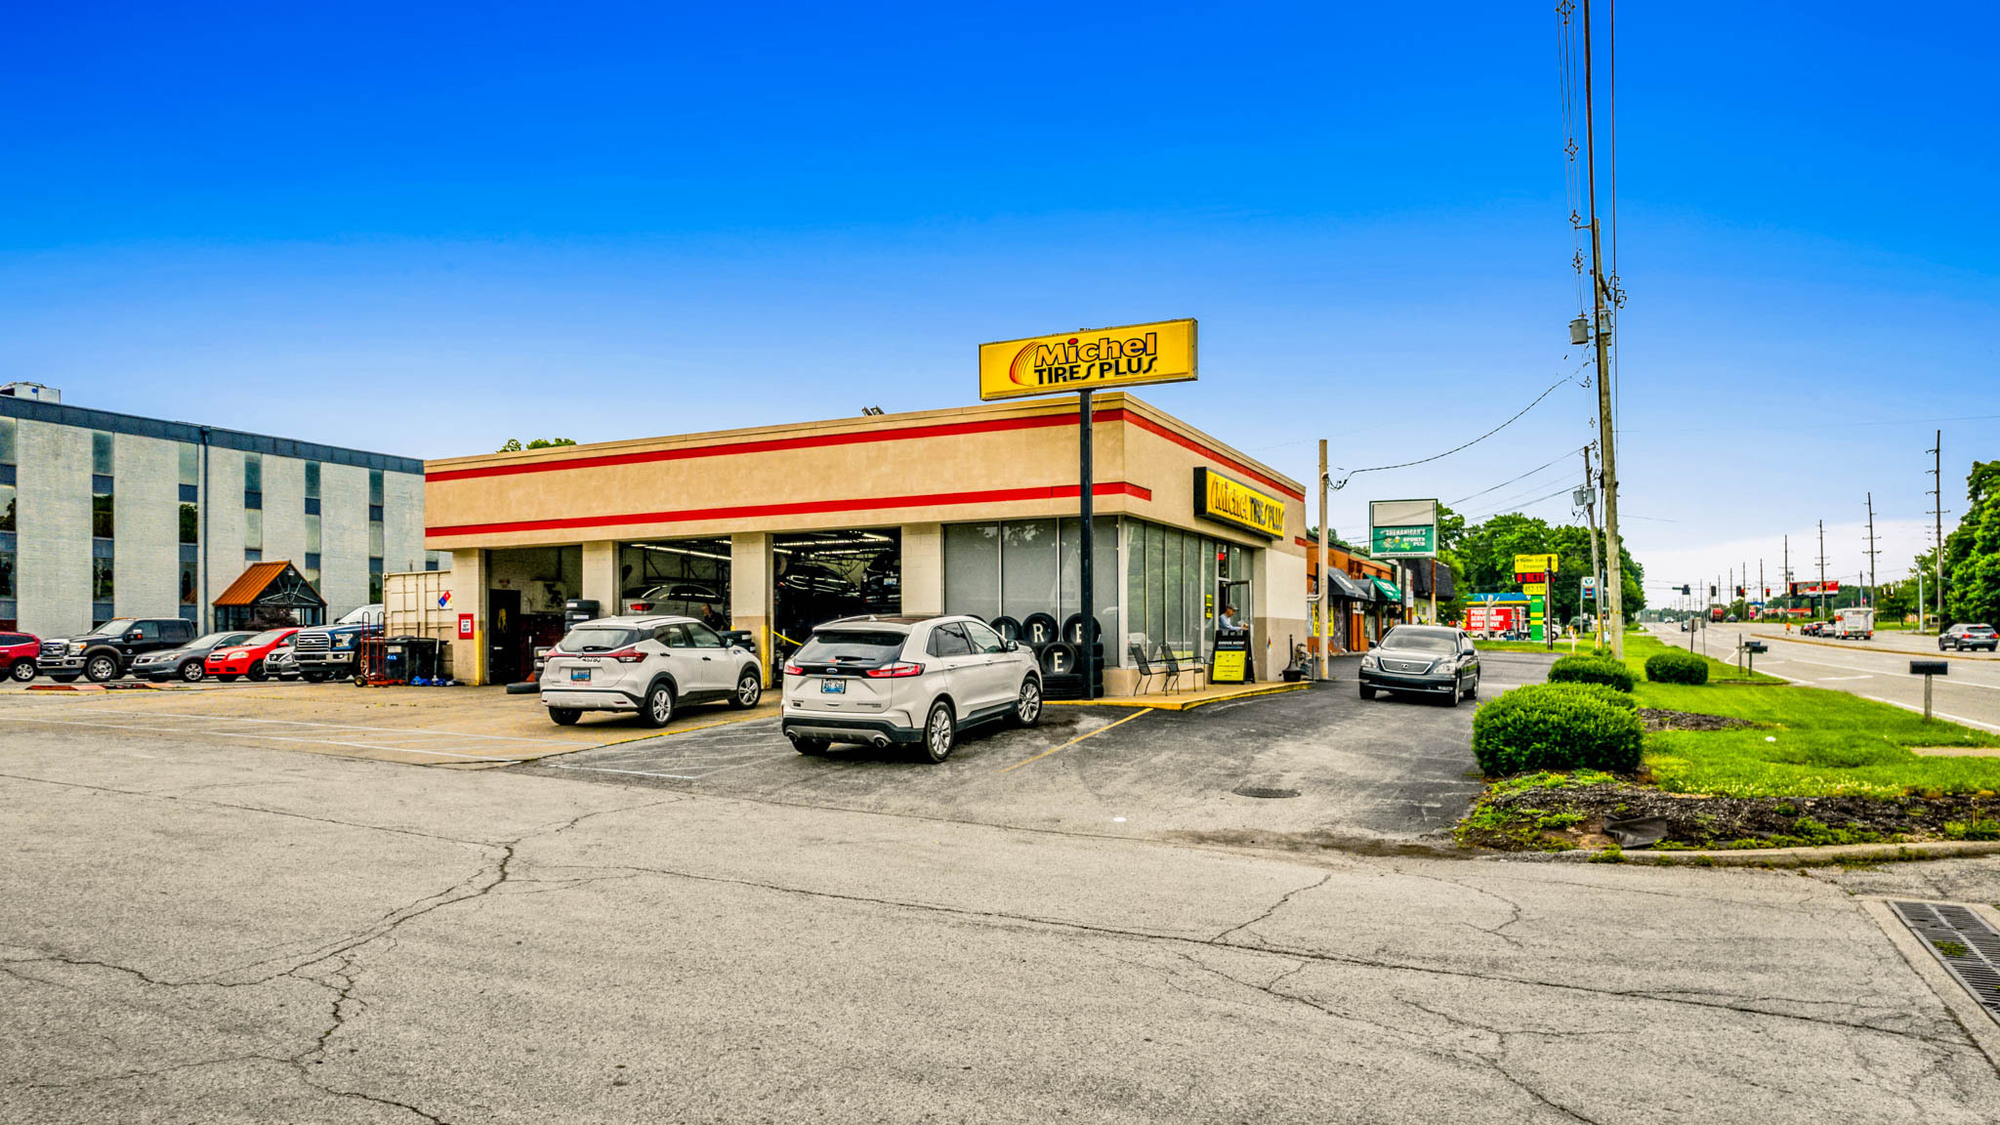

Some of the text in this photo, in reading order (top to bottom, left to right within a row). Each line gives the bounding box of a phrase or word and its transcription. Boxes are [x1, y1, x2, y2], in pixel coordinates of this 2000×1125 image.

[1034, 332, 1157, 368] Michel
[1034, 356, 1158, 385] TIRES PLUS
[1215, 481, 1284, 532] Michel TIRES PLUS
